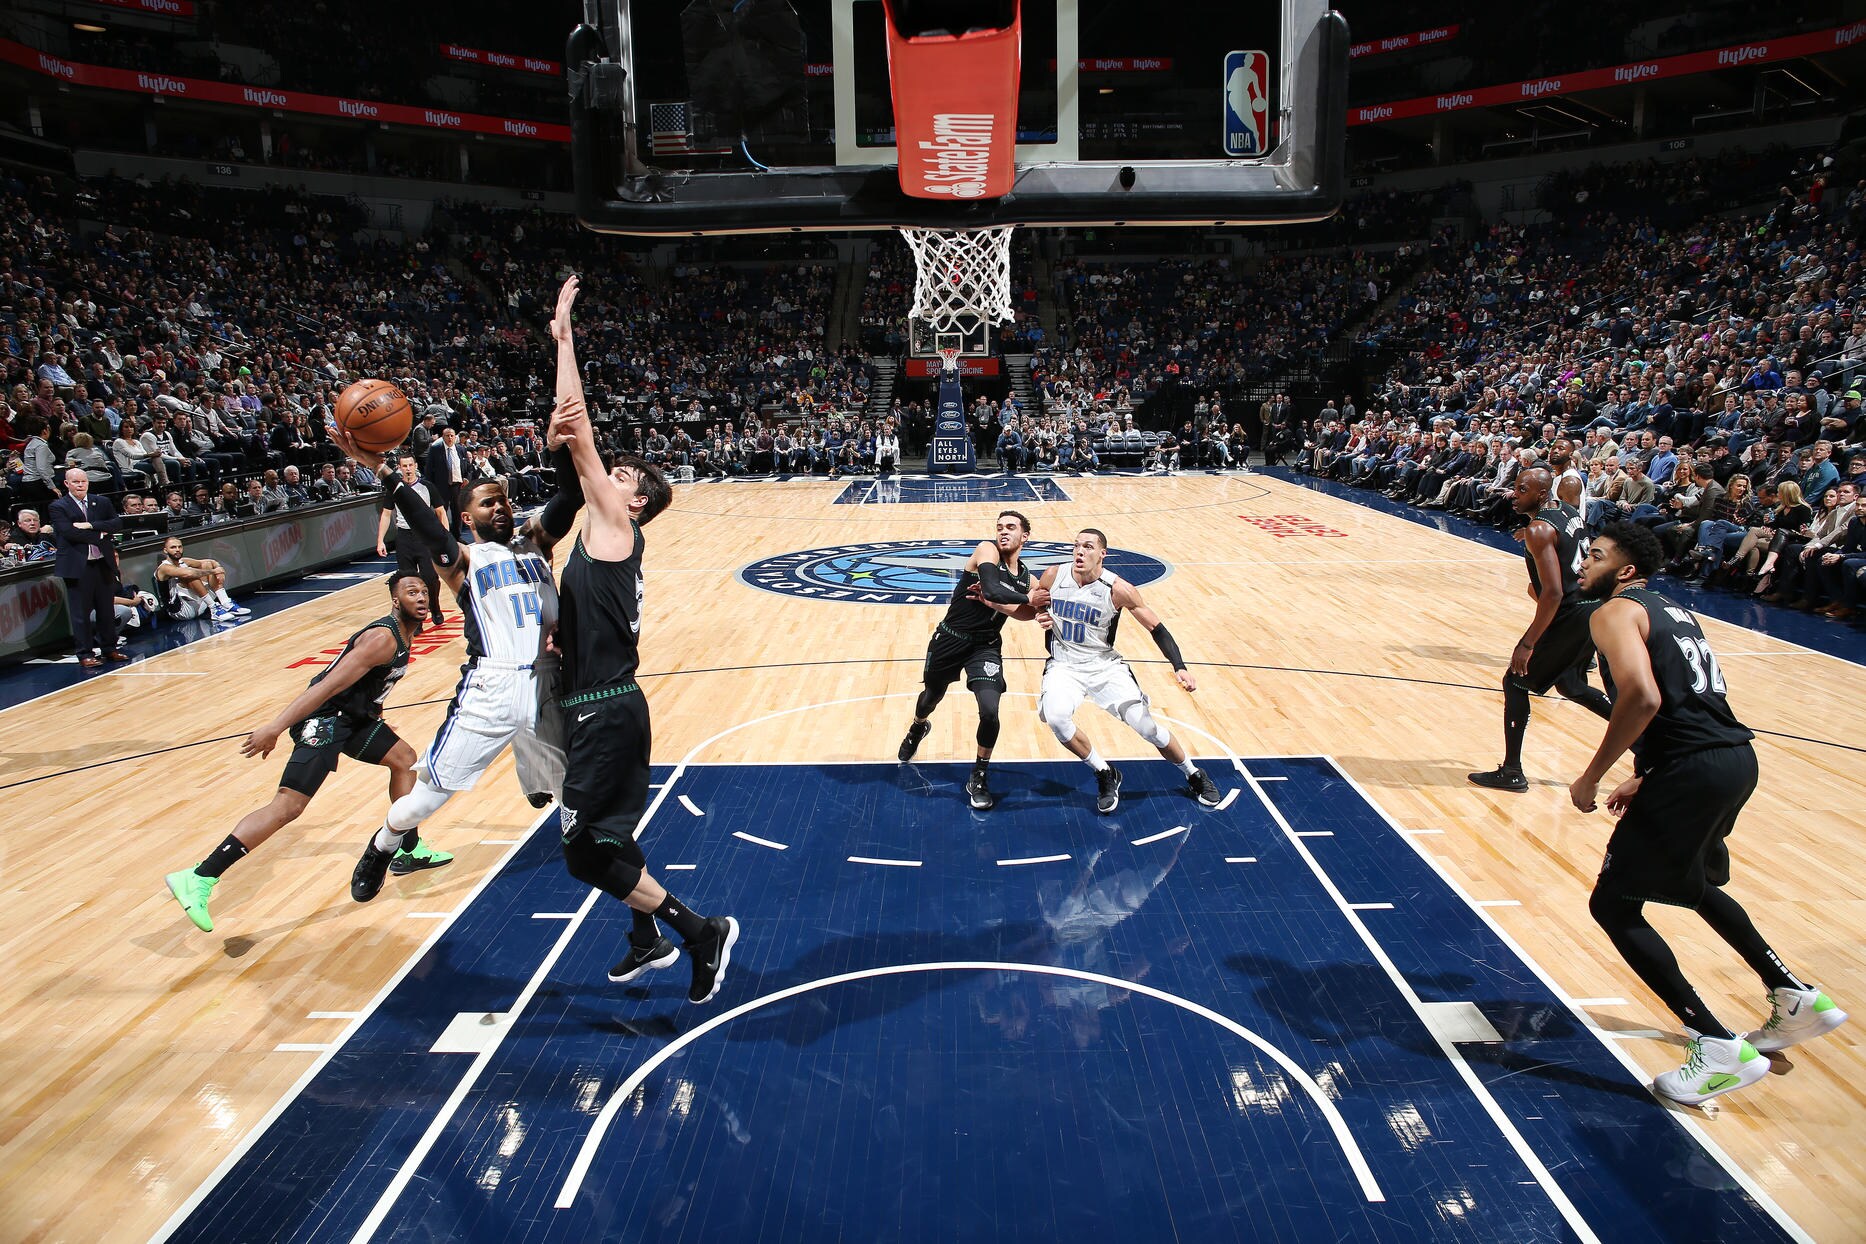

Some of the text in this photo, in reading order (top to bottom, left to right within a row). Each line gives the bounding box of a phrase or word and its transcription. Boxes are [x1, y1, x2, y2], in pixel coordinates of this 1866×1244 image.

[1382, 37, 1409, 50] HyVee
[487, 52, 516, 66] HyVee
[1718, 46, 1768, 65] HyVee
[39, 54, 75, 78] HyVee
[524, 58, 551, 72] HyVee
[1615, 64, 1659, 82] HyVee
[138, 74, 187, 93] HyVee
[1521, 80, 1561, 97] HyVee
[243, 88, 288, 105] HyVee
[1436, 94, 1473, 110] HyVee
[338, 100, 378, 117] HyVee
[1359, 106, 1393, 122] HyVee
[425, 111, 461, 127] HyVee
[504, 120, 537, 136] HyVee
[1230, 132, 1251, 149] NBA
[1668, 141, 1686, 150] 106
[215, 166, 233, 175] 136
[959, 367, 984, 375] EDICINE
[320, 511, 356, 557] LIBMAN
[260, 522, 305, 575] LIBMAN
[475, 557, 549, 599] MAGIC
[0, 579, 58, 639] BMAN
[509, 591, 544, 629] 14
[1052, 599, 1101, 627] MAGIC
[1062, 621, 1086, 644] 00
[1672, 634, 1728, 694] 32
